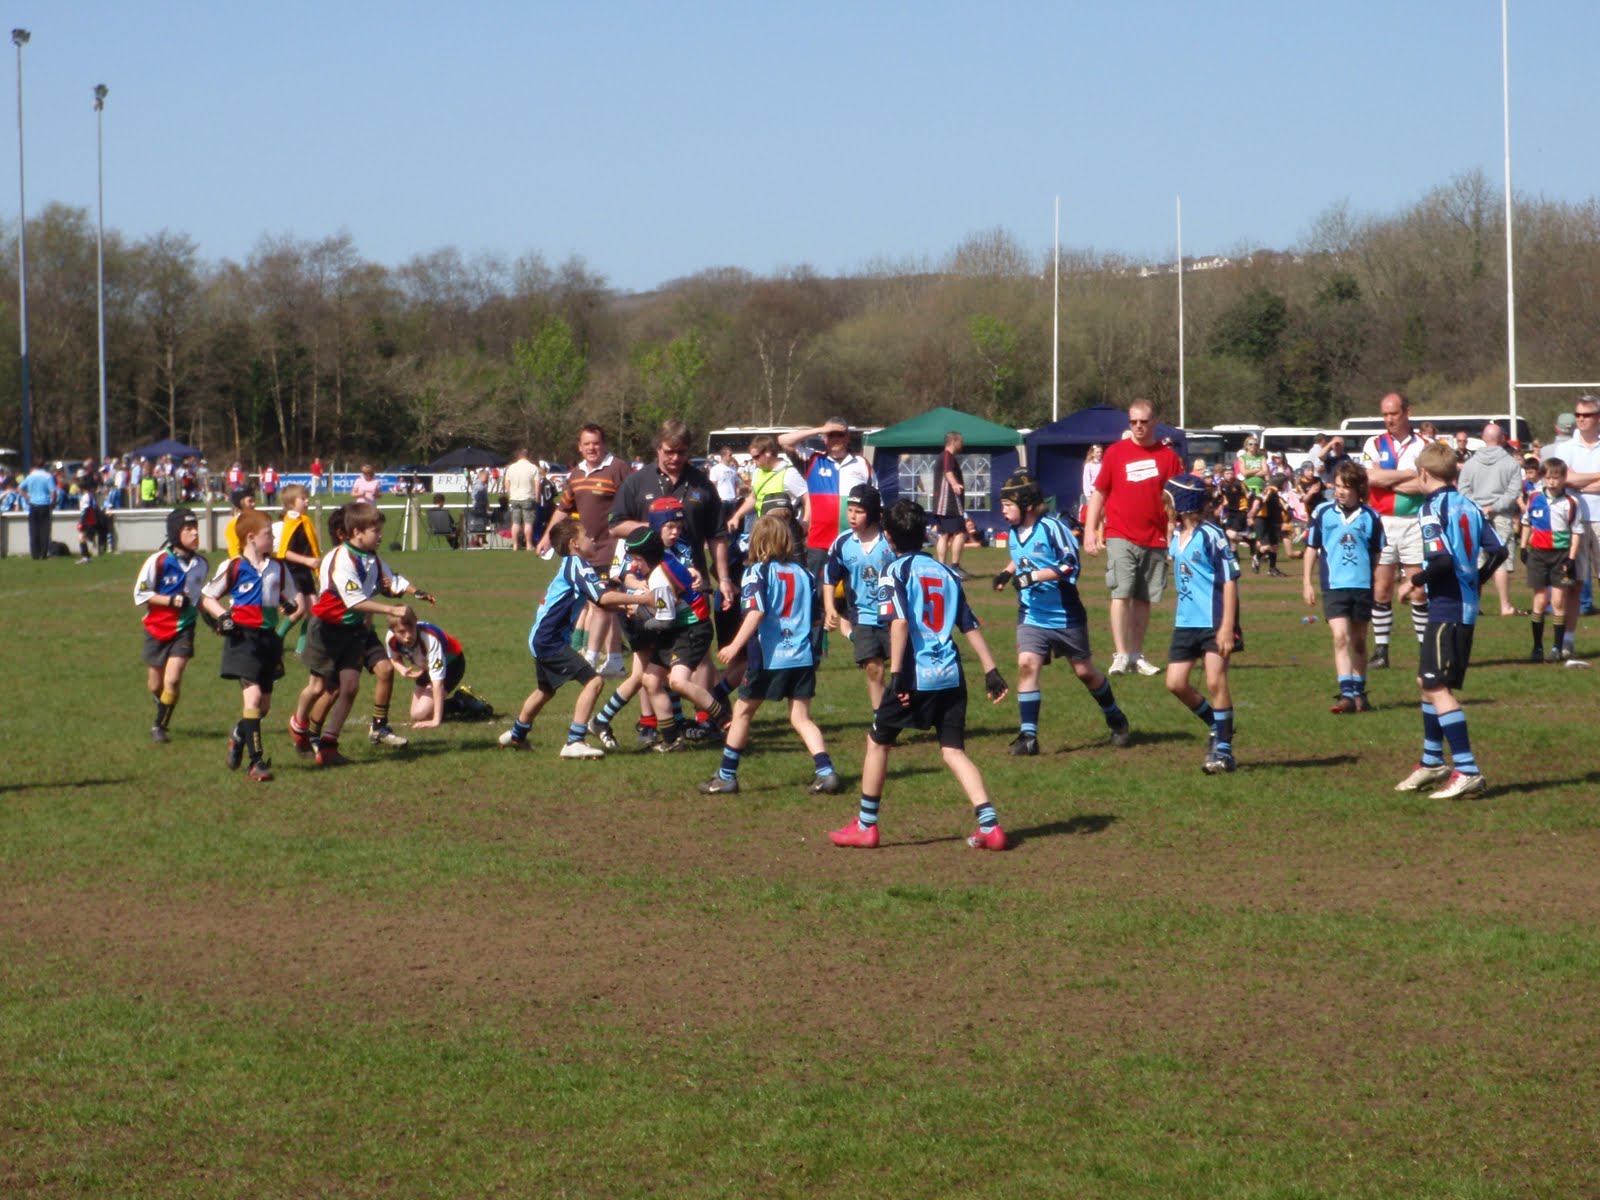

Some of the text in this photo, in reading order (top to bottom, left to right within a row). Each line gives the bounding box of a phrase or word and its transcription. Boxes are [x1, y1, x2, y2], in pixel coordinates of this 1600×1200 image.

[1458, 513, 1473, 562] 1
[777, 572, 796, 618] 7
[919, 576, 945, 633] 5
